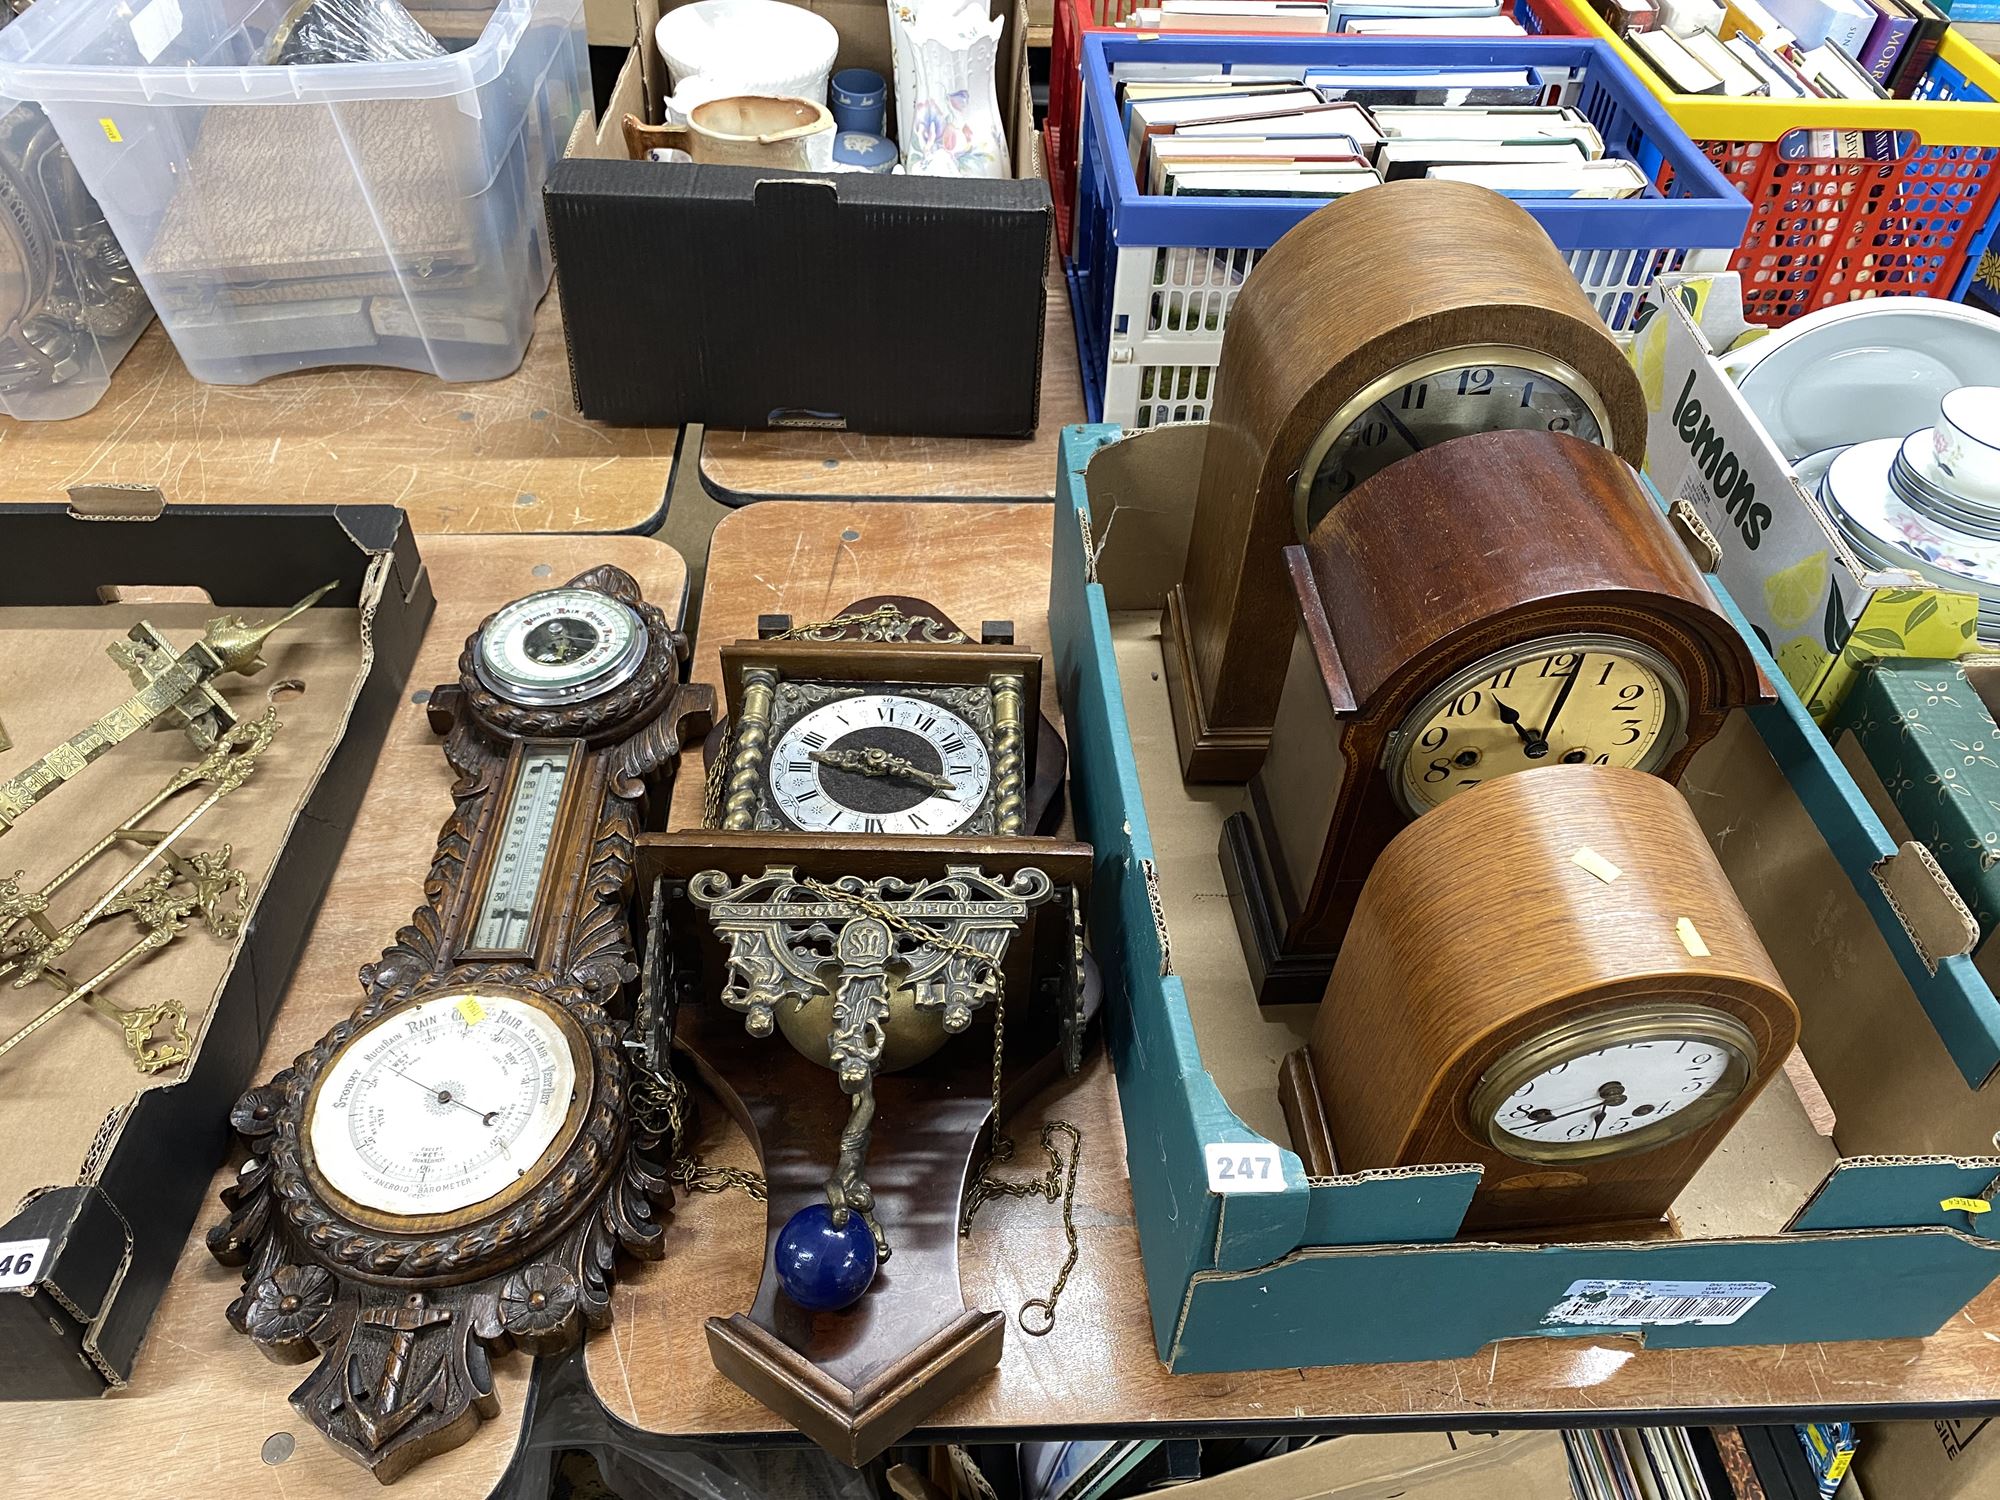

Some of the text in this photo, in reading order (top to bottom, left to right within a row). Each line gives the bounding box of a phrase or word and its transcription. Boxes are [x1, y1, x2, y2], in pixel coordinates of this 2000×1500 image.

[1842, 27, 1857, 47] SUN
[1872, 30, 1905, 79] MORR
[1456, 368, 1495, 396] 12
[1400, 383, 1428, 410] 11
[1519, 382, 1534, 408] 1
[1672, 368, 1773, 551] lemons
[1488, 666, 1518, 690] 11
[1537, 653, 1578, 678] 12
[1595, 661, 1615, 686] 1
[1444, 690, 1482, 718] 10
[1611, 684, 1645, 711] 2
[1421, 726, 1449, 754] 9
[1611, 719, 1643, 746] 3
[788, 761, 813, 773] III
[1423, 757, 1451, 784] 8
[795, 789, 820, 804] II
[504, 853, 516, 862] 60
[493, 892, 507, 902] 30
[332, 1068, 362, 1109] STORMY
[404, 1015, 437, 1034] RAIN
[494, 1009, 523, 1030] FAIR
[1217, 1156, 1271, 1180] 247
[373, 1177, 472, 1194] ANEROID BAROMETER
[0, 1253, 34, 1276] 46
